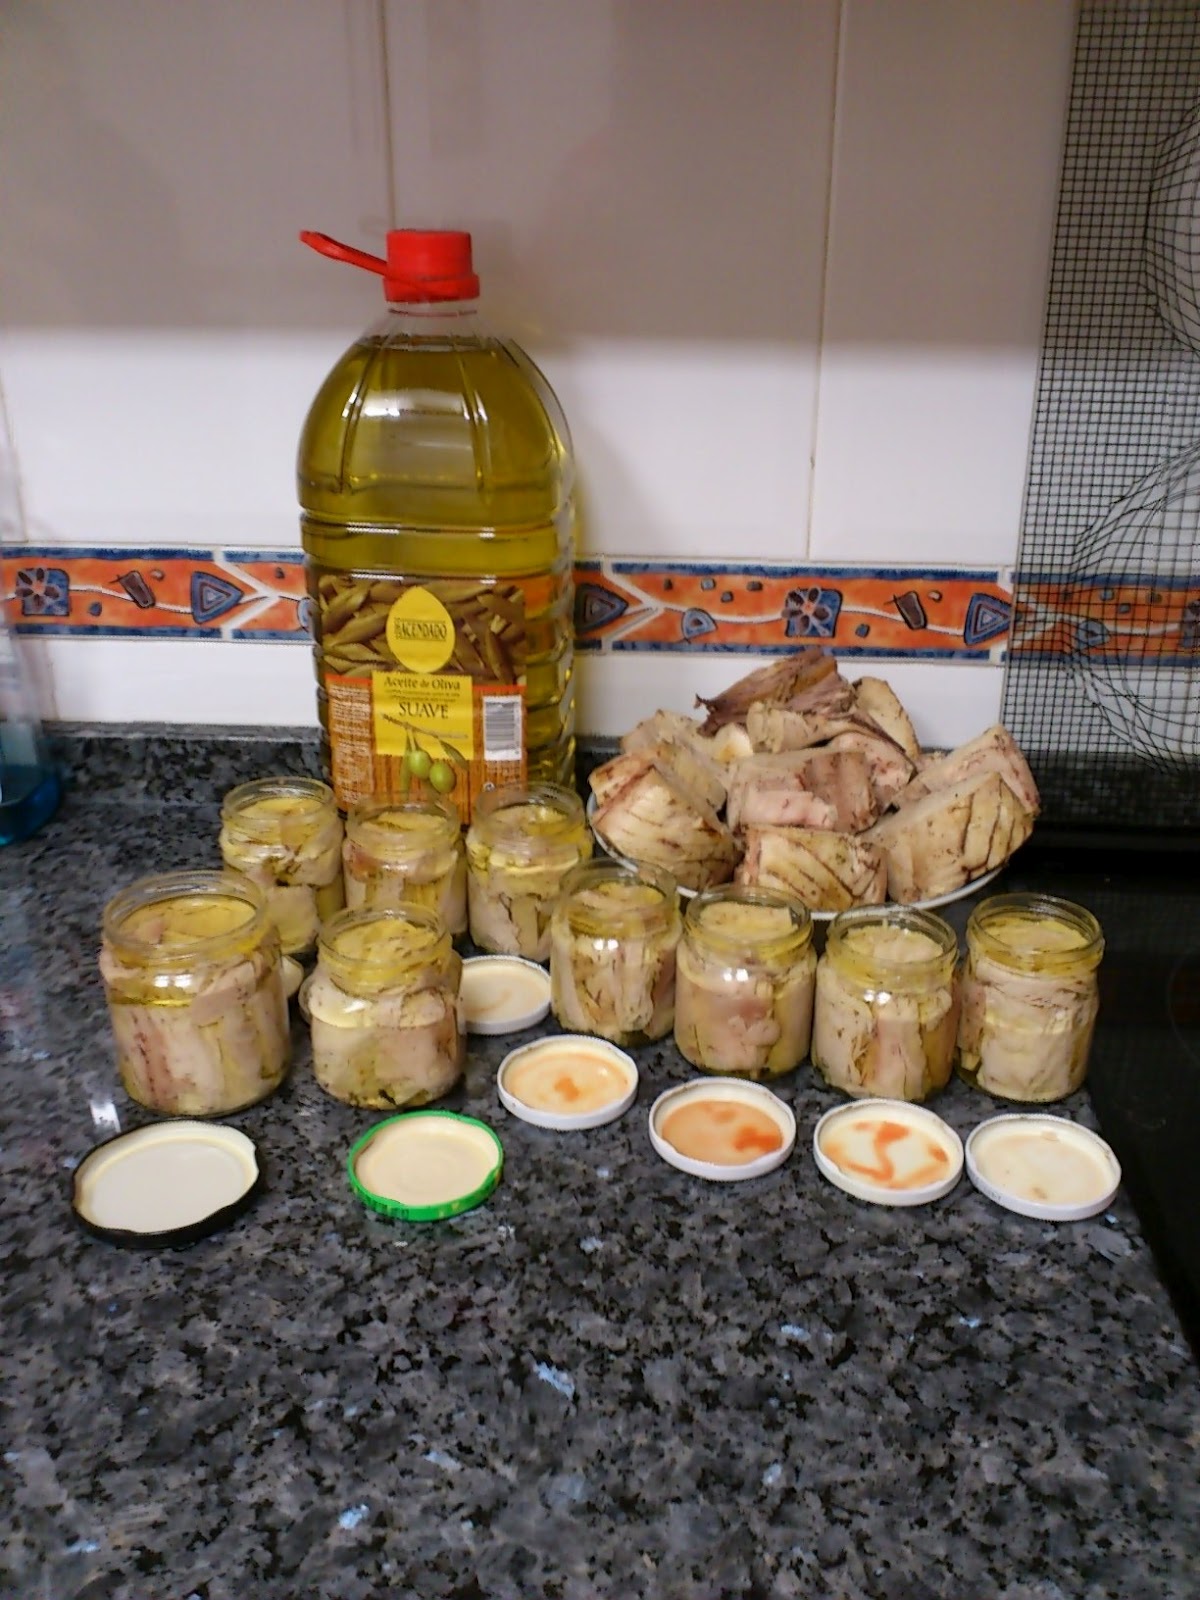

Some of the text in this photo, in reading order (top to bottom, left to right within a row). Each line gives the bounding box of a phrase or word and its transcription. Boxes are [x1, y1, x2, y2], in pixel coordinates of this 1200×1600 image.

[384, 676, 460, 690] Aceite de Oliva
[399, 702, 448, 719] SUAVE
